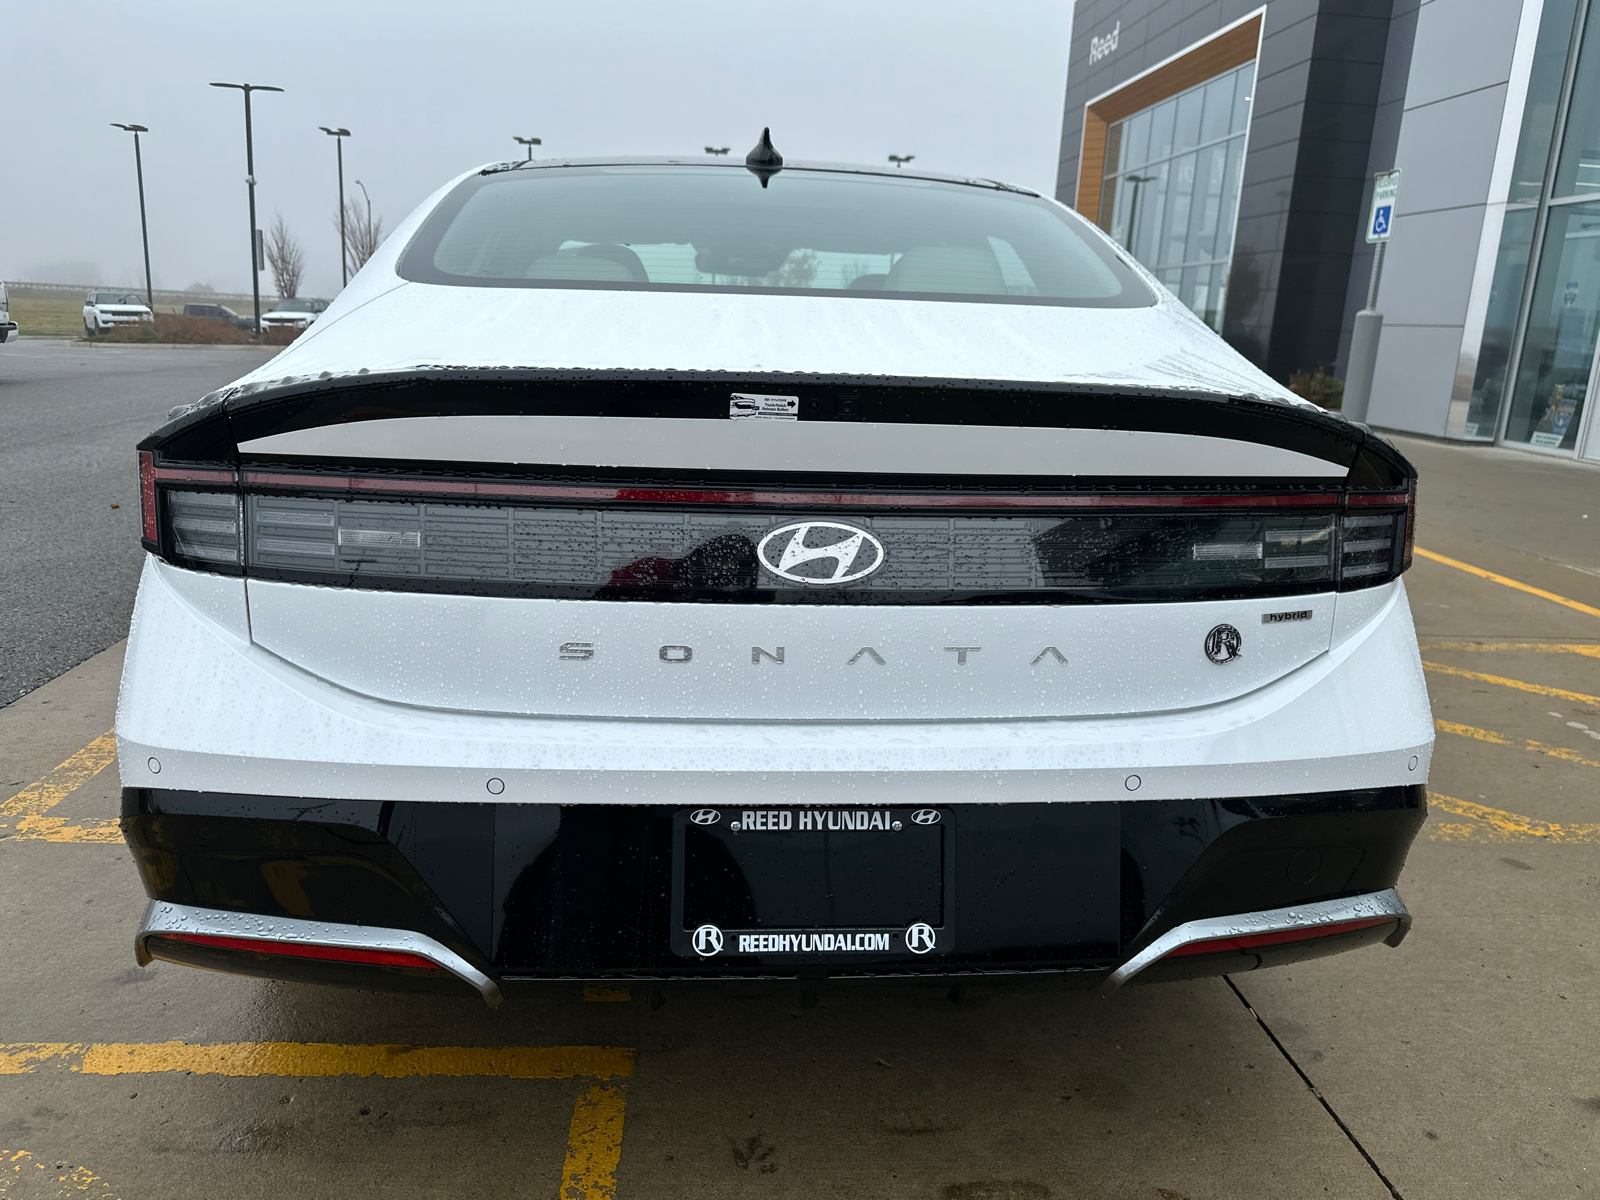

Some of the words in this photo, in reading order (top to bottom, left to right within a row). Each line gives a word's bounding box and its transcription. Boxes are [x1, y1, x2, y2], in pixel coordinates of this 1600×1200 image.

[1089, 20, 1120, 66] Reed
[1270, 610, 1308, 622] hybrid
[558, 641, 1069, 667] SONATA
[742, 810, 792, 831] REED
[798, 810, 891, 831] HYUNDAI
[738, 933, 890, 953] REEDHYUNDAI.COM
